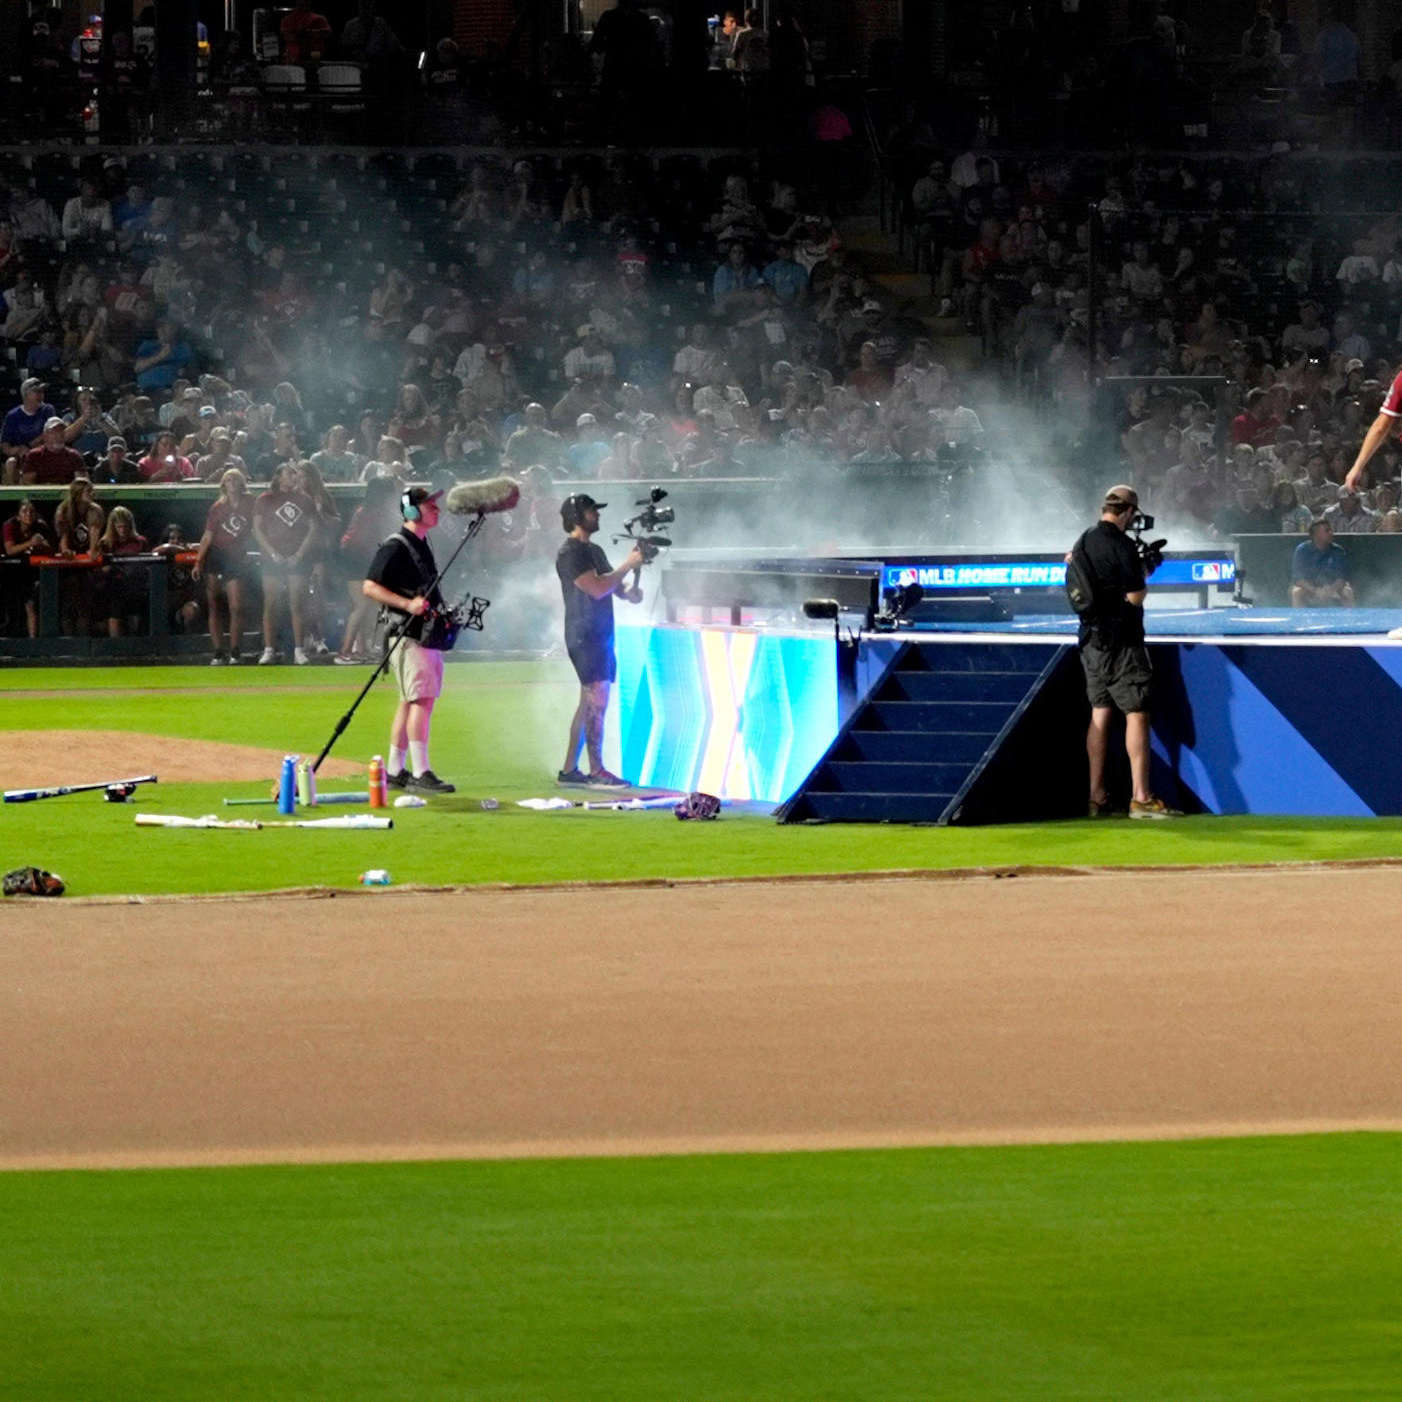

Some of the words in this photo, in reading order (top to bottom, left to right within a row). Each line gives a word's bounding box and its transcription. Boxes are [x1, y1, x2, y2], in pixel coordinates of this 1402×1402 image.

[918, 566, 956, 584] MLB
[957, 566, 1010, 584] HOME
[1011, 565, 1050, 583] RUN
